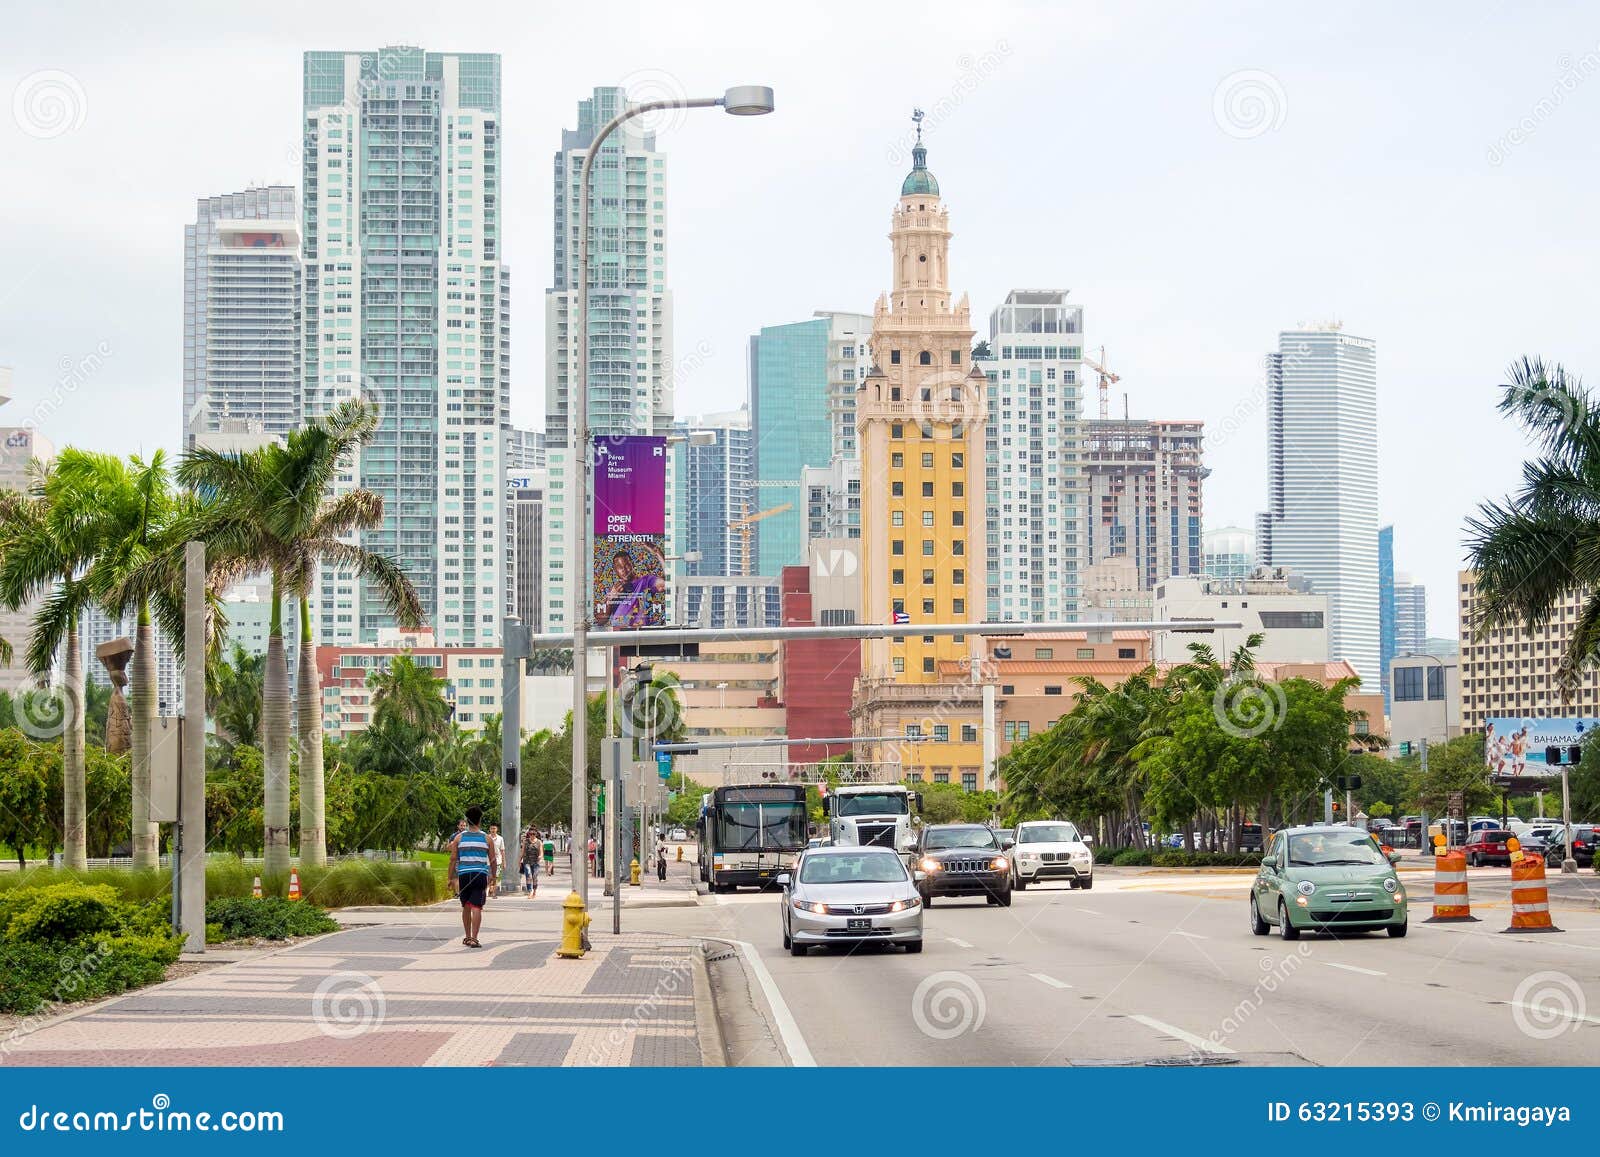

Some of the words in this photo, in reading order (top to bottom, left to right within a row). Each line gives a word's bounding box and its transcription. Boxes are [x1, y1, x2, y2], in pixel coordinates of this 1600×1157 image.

[607, 515, 632, 523] OPEN
[607, 524, 626, 532] FOR
[607, 534, 654, 542] STRENGTH
[1534, 735, 1578, 744] BAHAMAS
